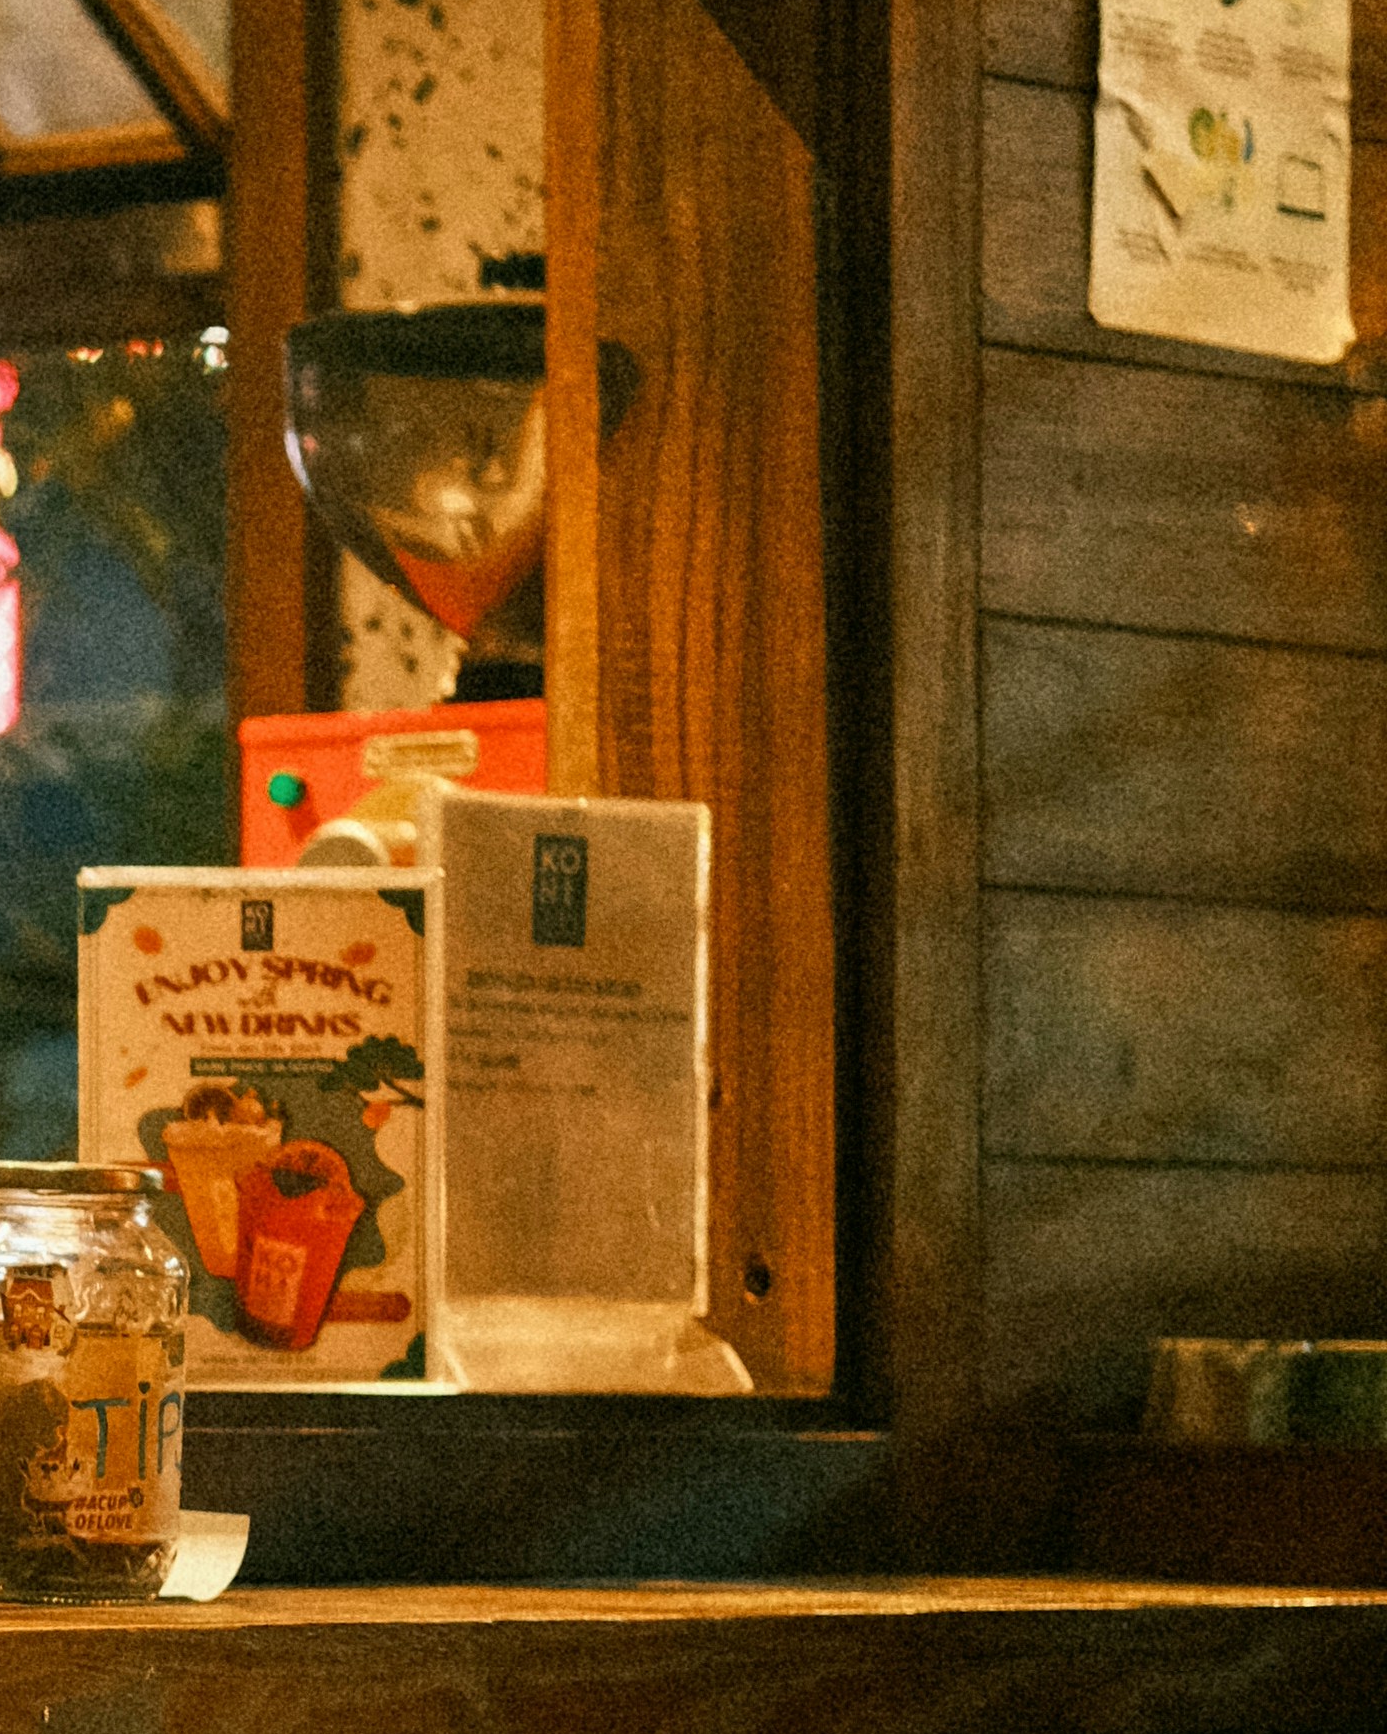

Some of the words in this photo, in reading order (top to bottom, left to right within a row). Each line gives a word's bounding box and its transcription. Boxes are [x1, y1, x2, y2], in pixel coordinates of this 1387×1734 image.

[135, 958, 248, 1006] ENJOY
[261, 955, 393, 1005] SPRING
[239, 1012, 363, 1037] DRINKS
